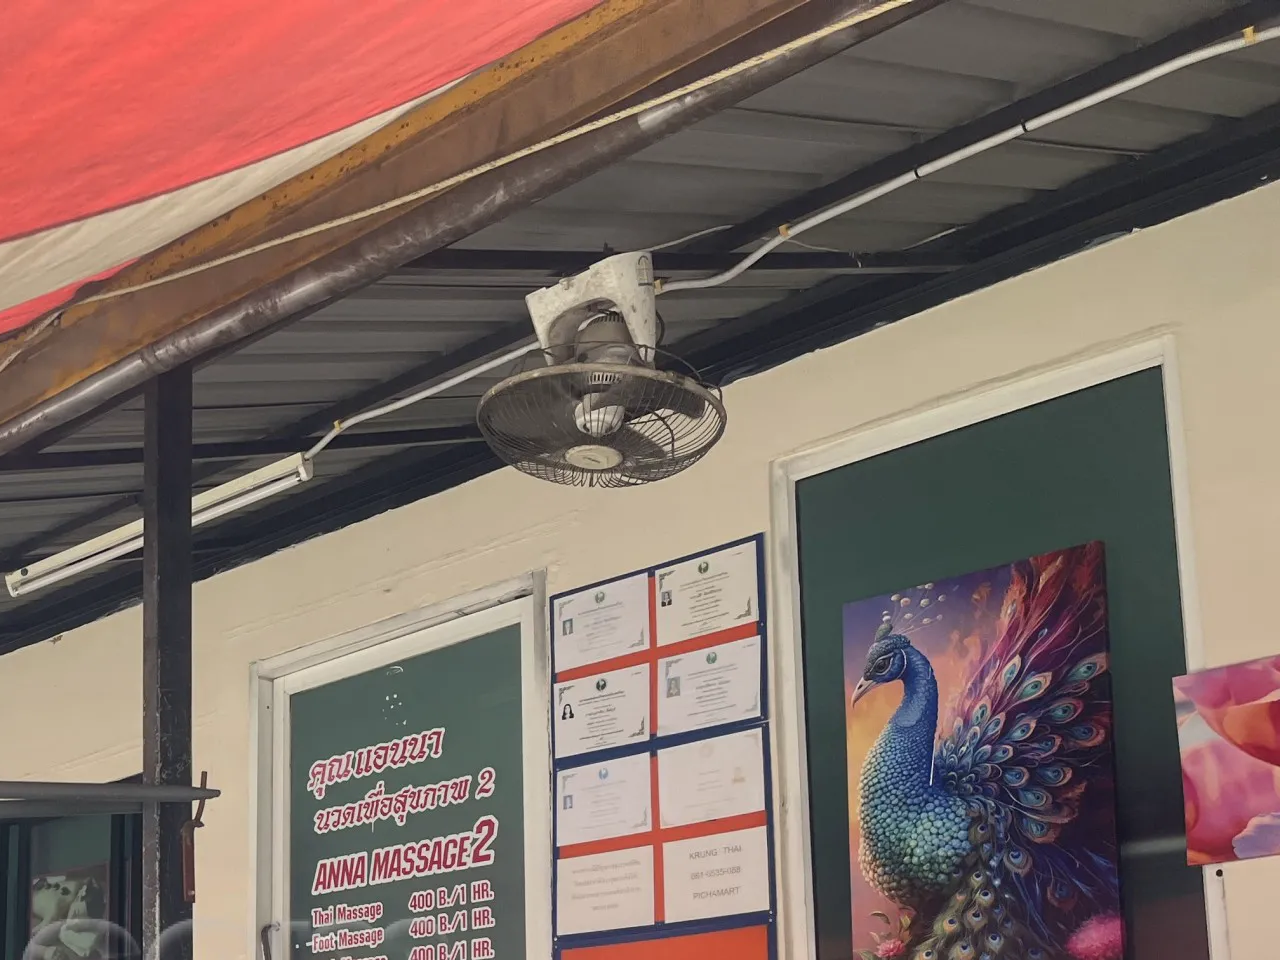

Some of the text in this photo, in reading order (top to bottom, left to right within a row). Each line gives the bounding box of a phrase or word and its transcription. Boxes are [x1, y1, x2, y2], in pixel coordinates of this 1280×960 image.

[308, 728, 444, 799] คุณแอนนา
[314, 767, 495, 834] นวดเพื่อสุขภาพ 2
[312, 852, 367, 894] ANNA
[370, 832, 472, 885] MASSAGE
[312, 907, 333, 927] Thai
[336, 902, 383, 923] Massage
[409, 892, 433, 912] 400
[471, 881, 494, 904] HR.
[312, 933, 335, 953] Foot
[337, 928, 384, 950] Massage
[409, 919, 435, 938] 400
[472, 907, 495, 930] HR.
[472, 938, 495, 960] HR.
